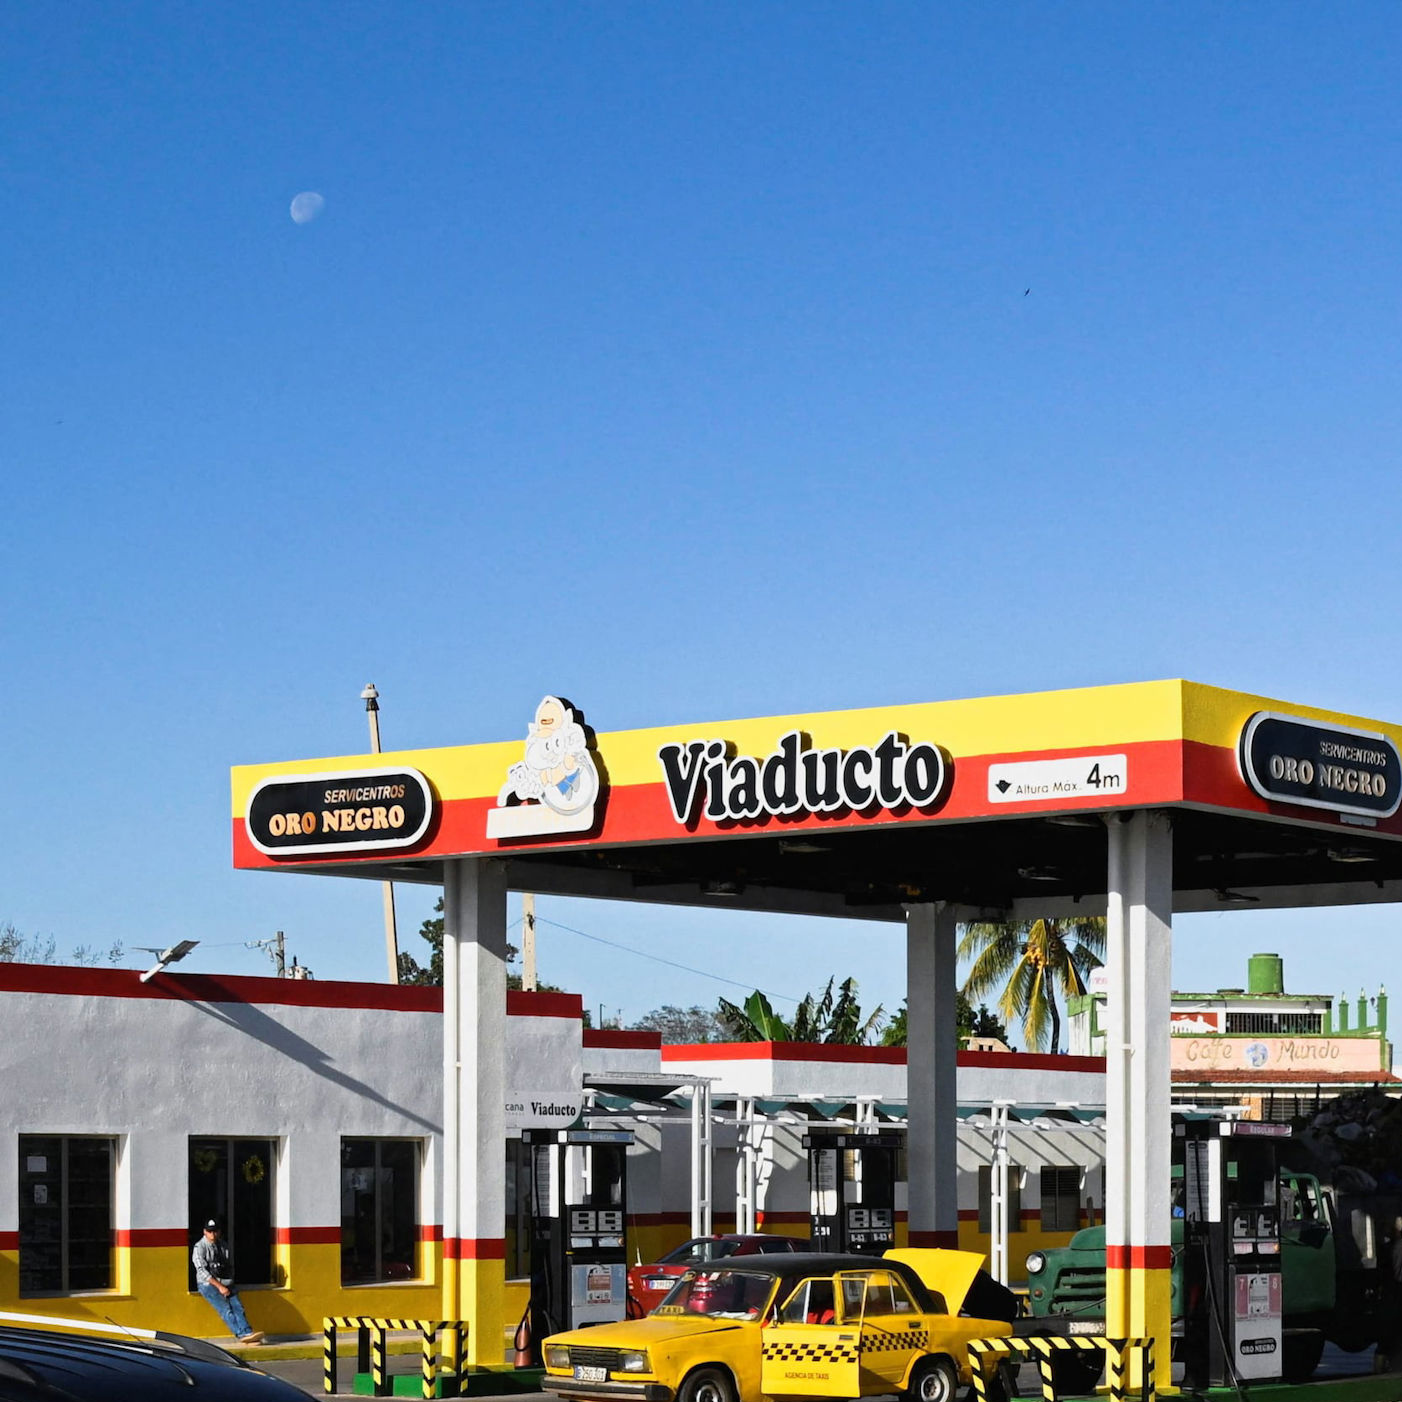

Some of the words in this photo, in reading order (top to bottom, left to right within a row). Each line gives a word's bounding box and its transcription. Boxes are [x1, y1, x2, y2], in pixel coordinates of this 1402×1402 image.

[1319, 741, 1387, 767] SERVICENTROS
[659, 730, 944, 824] Viaducto
[1269, 754, 1314, 785] ORO
[1318, 763, 1387, 798] NEGRO
[324, 784, 406, 804] SERVICENTROS
[1016, 785, 1049, 795] Altura
[268, 811, 317, 837] ORO
[321, 804, 405, 833] NEGRO
[1277, 1040, 1340, 1062] Mundo
[505, 1103, 524, 1112] cana
[530, 1102, 577, 1116] Viaducto
[661, 1306, 681, 1314] TAXI
[1255, 1343, 1275, 1353] NEGRO
[785, 1371, 807, 1379] AGENCIA
